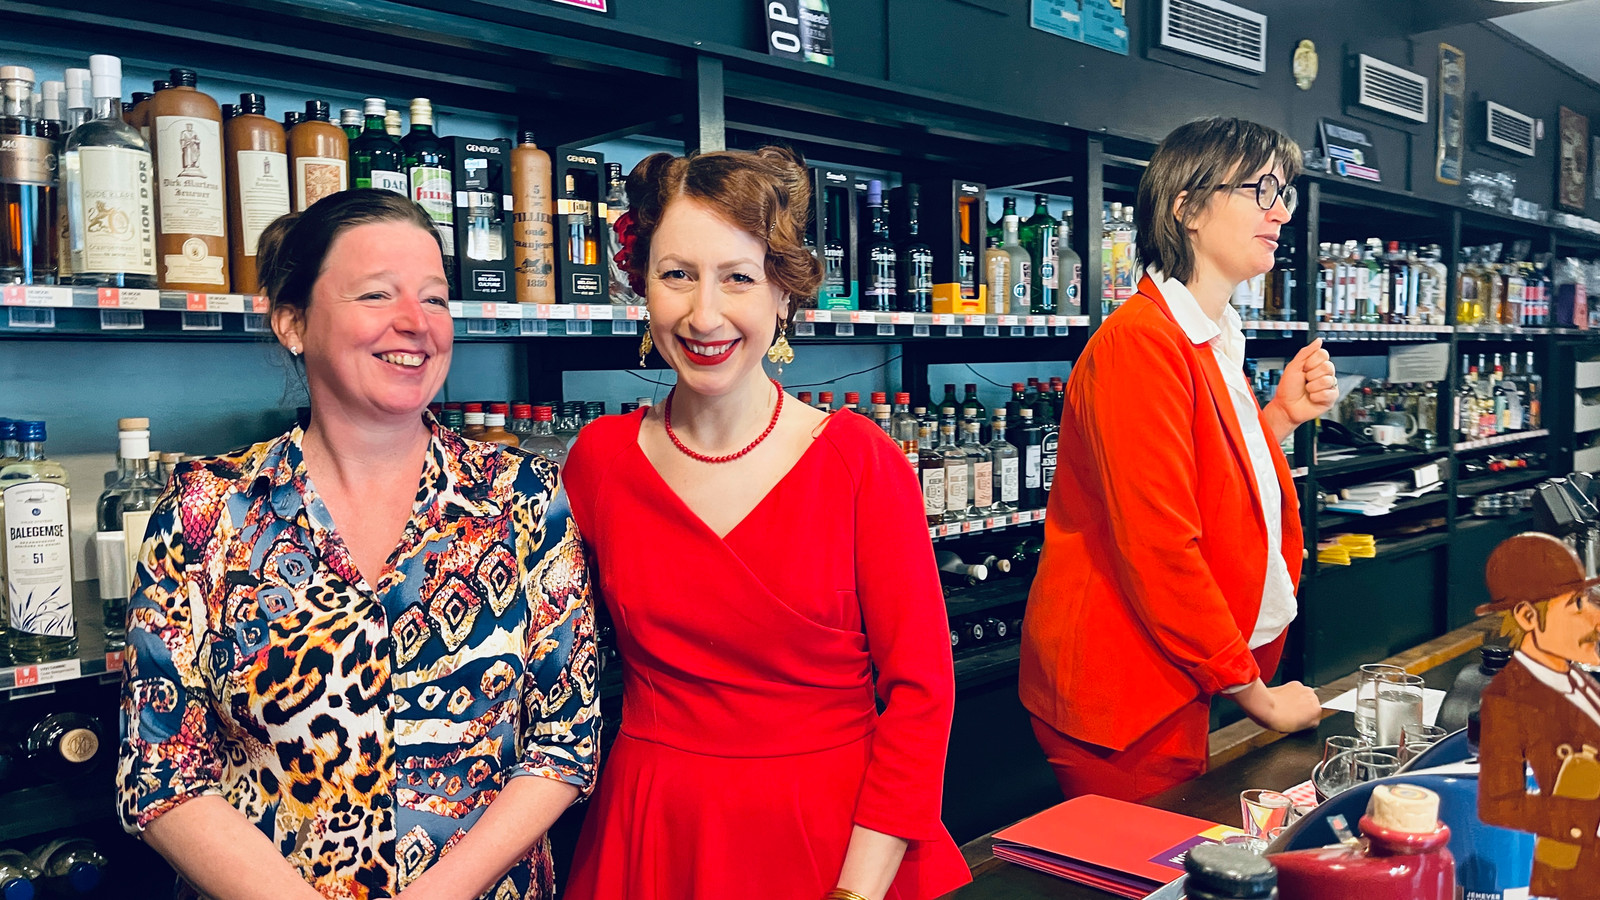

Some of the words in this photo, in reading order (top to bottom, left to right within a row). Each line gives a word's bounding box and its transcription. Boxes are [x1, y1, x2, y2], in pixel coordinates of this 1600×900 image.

[141, 205, 151, 242] LION
[10, 524, 64, 541] BALEGEMSE
[33, 552, 44, 564] 51
[1467, 891, 1500, 900] JENEVER
